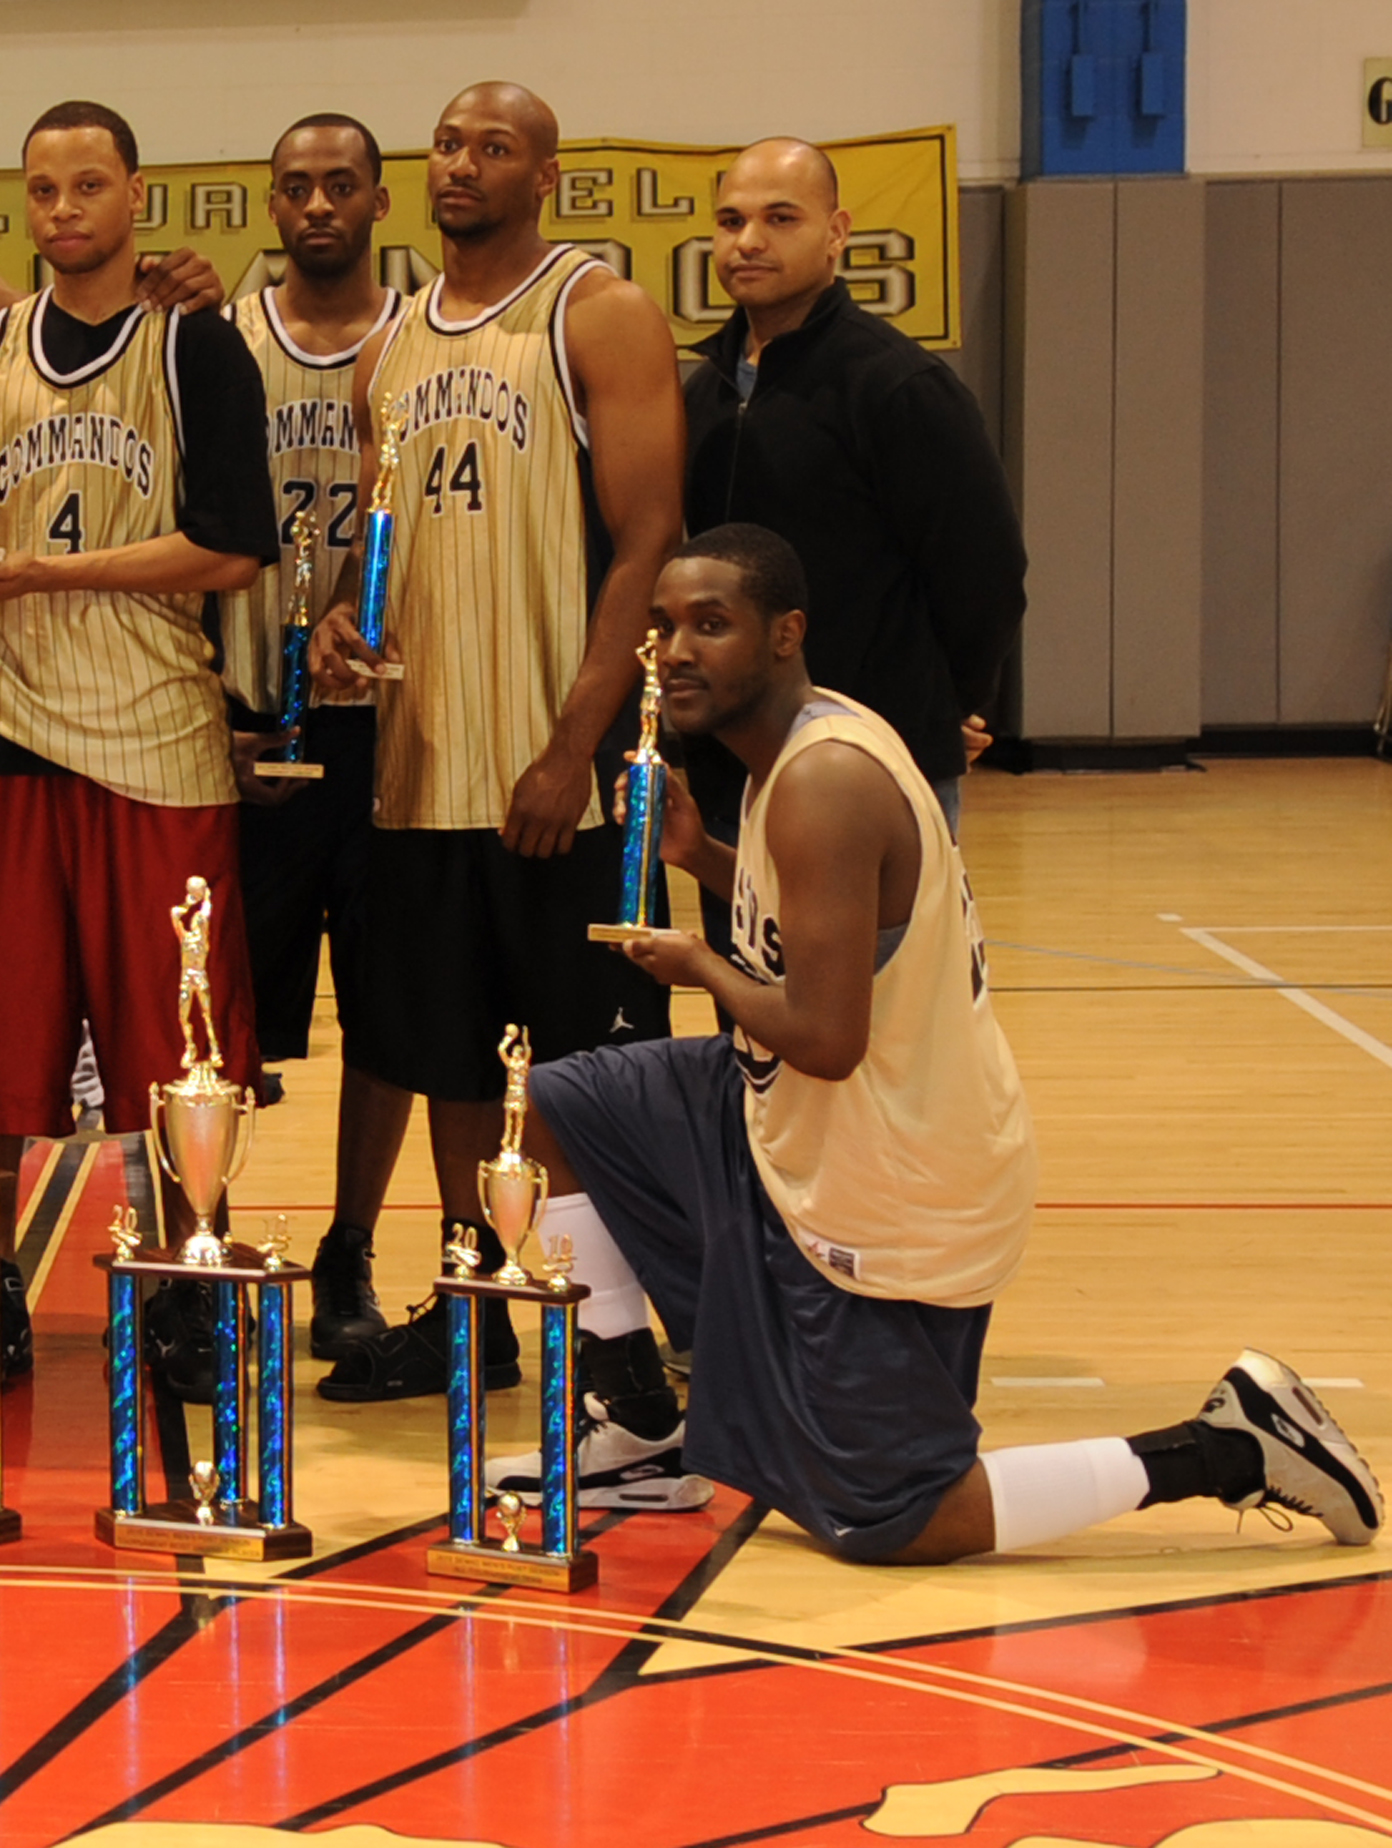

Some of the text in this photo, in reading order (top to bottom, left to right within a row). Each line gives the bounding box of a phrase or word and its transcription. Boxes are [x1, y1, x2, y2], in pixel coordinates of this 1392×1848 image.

[279, 477, 359, 549] 22
[423, 438, 483, 518] 44
[47, 489, 86, 555] 4
